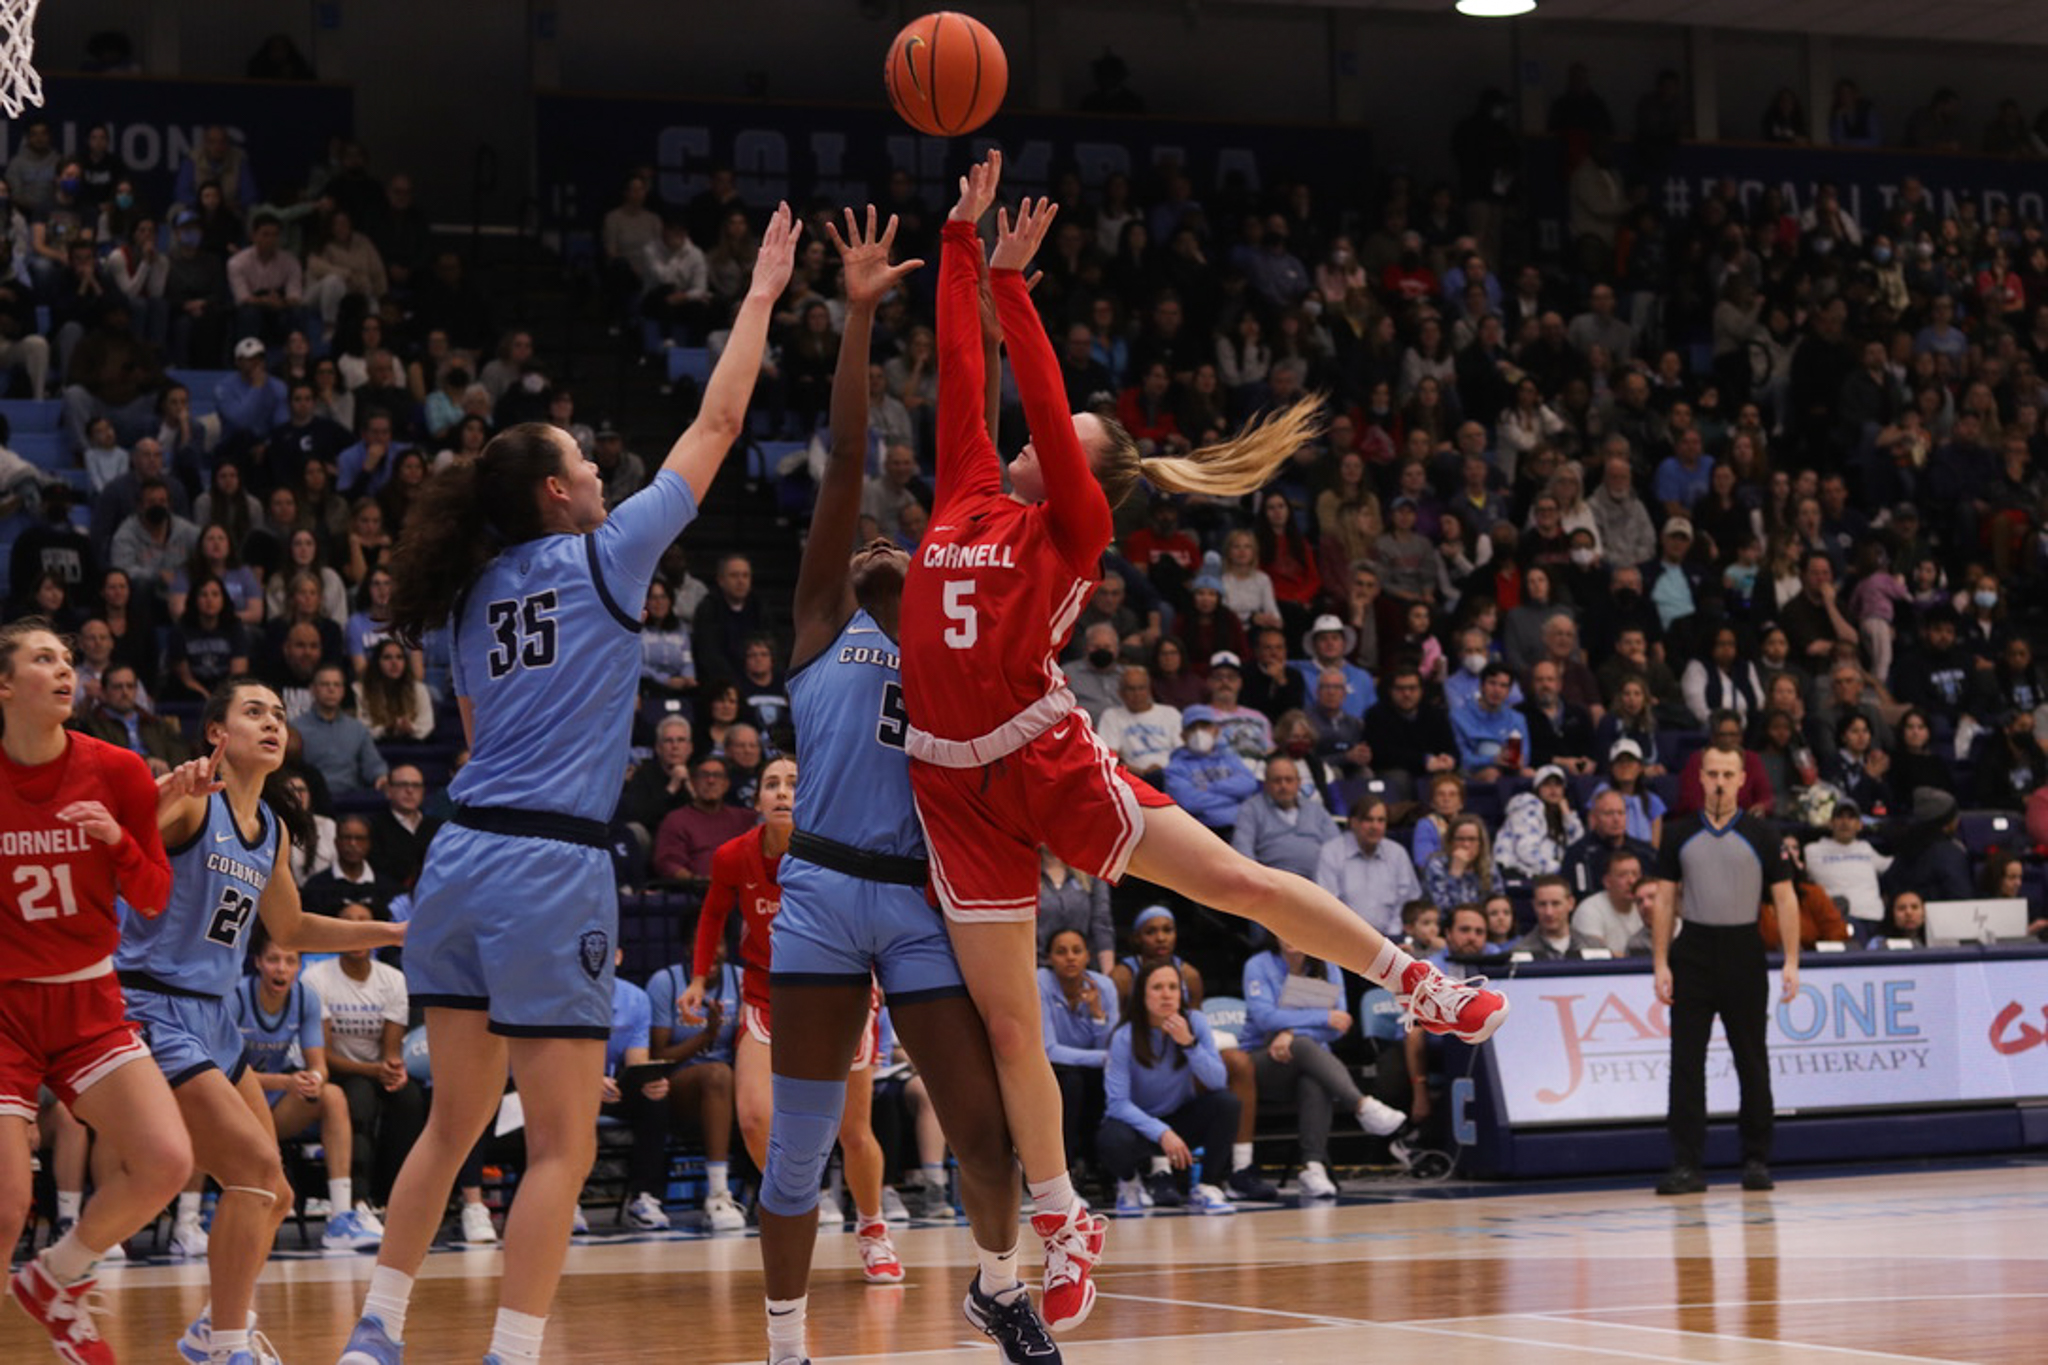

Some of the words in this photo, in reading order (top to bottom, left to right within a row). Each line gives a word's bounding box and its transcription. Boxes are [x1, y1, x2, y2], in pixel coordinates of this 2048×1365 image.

[923, 543, 1015, 569] CORNELL
[487, 588, 559, 680] 35
[942, 579, 978, 649] 5
[838, 646, 900, 670] COLU
[875, 681, 909, 750] 5
[12, 863, 78, 921] 21
[1769, 1048, 1930, 1076] THERAPY
[1451, 1076, 1477, 1146] C
